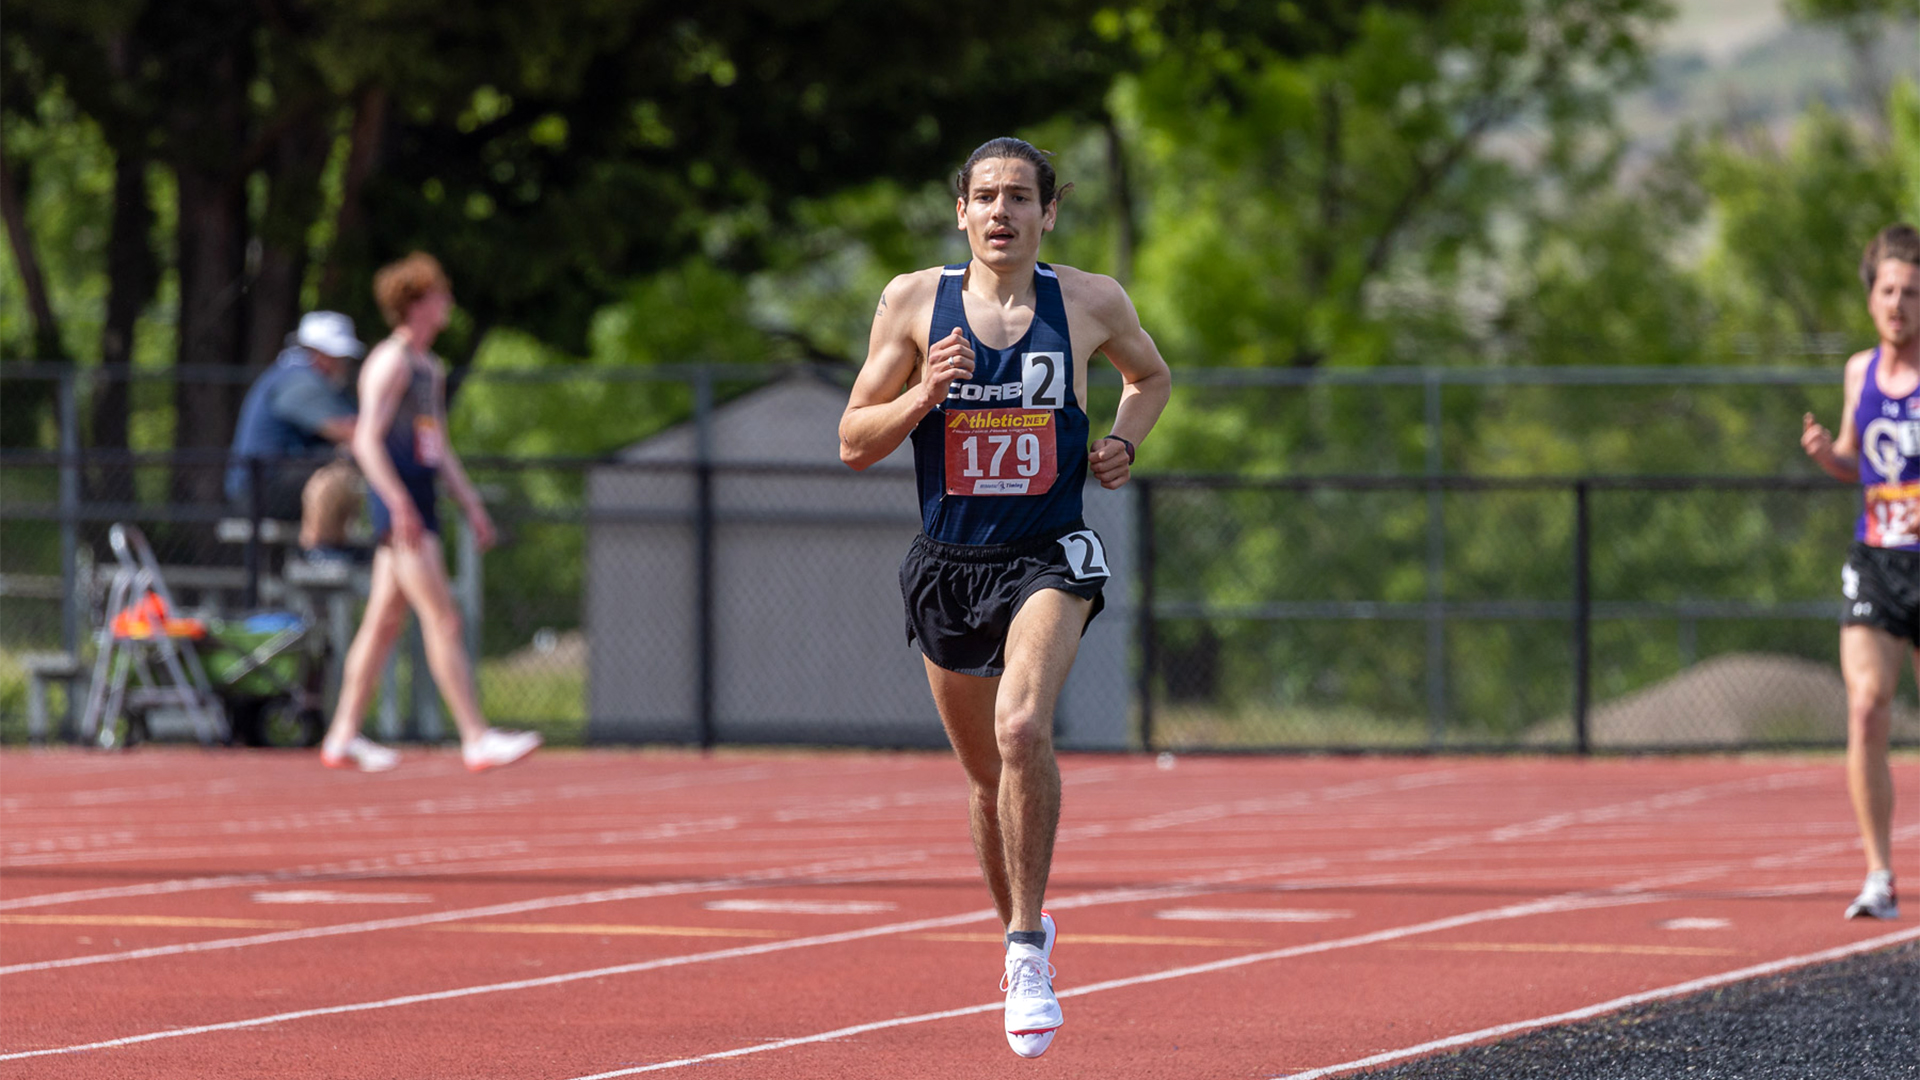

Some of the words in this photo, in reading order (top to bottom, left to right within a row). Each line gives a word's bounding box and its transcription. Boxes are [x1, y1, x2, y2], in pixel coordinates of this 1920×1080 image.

[947, 381, 1023, 402] CORB
[1031, 355, 1057, 406] 2
[962, 433, 1041, 477] 179
[1067, 533, 1105, 575] 2
